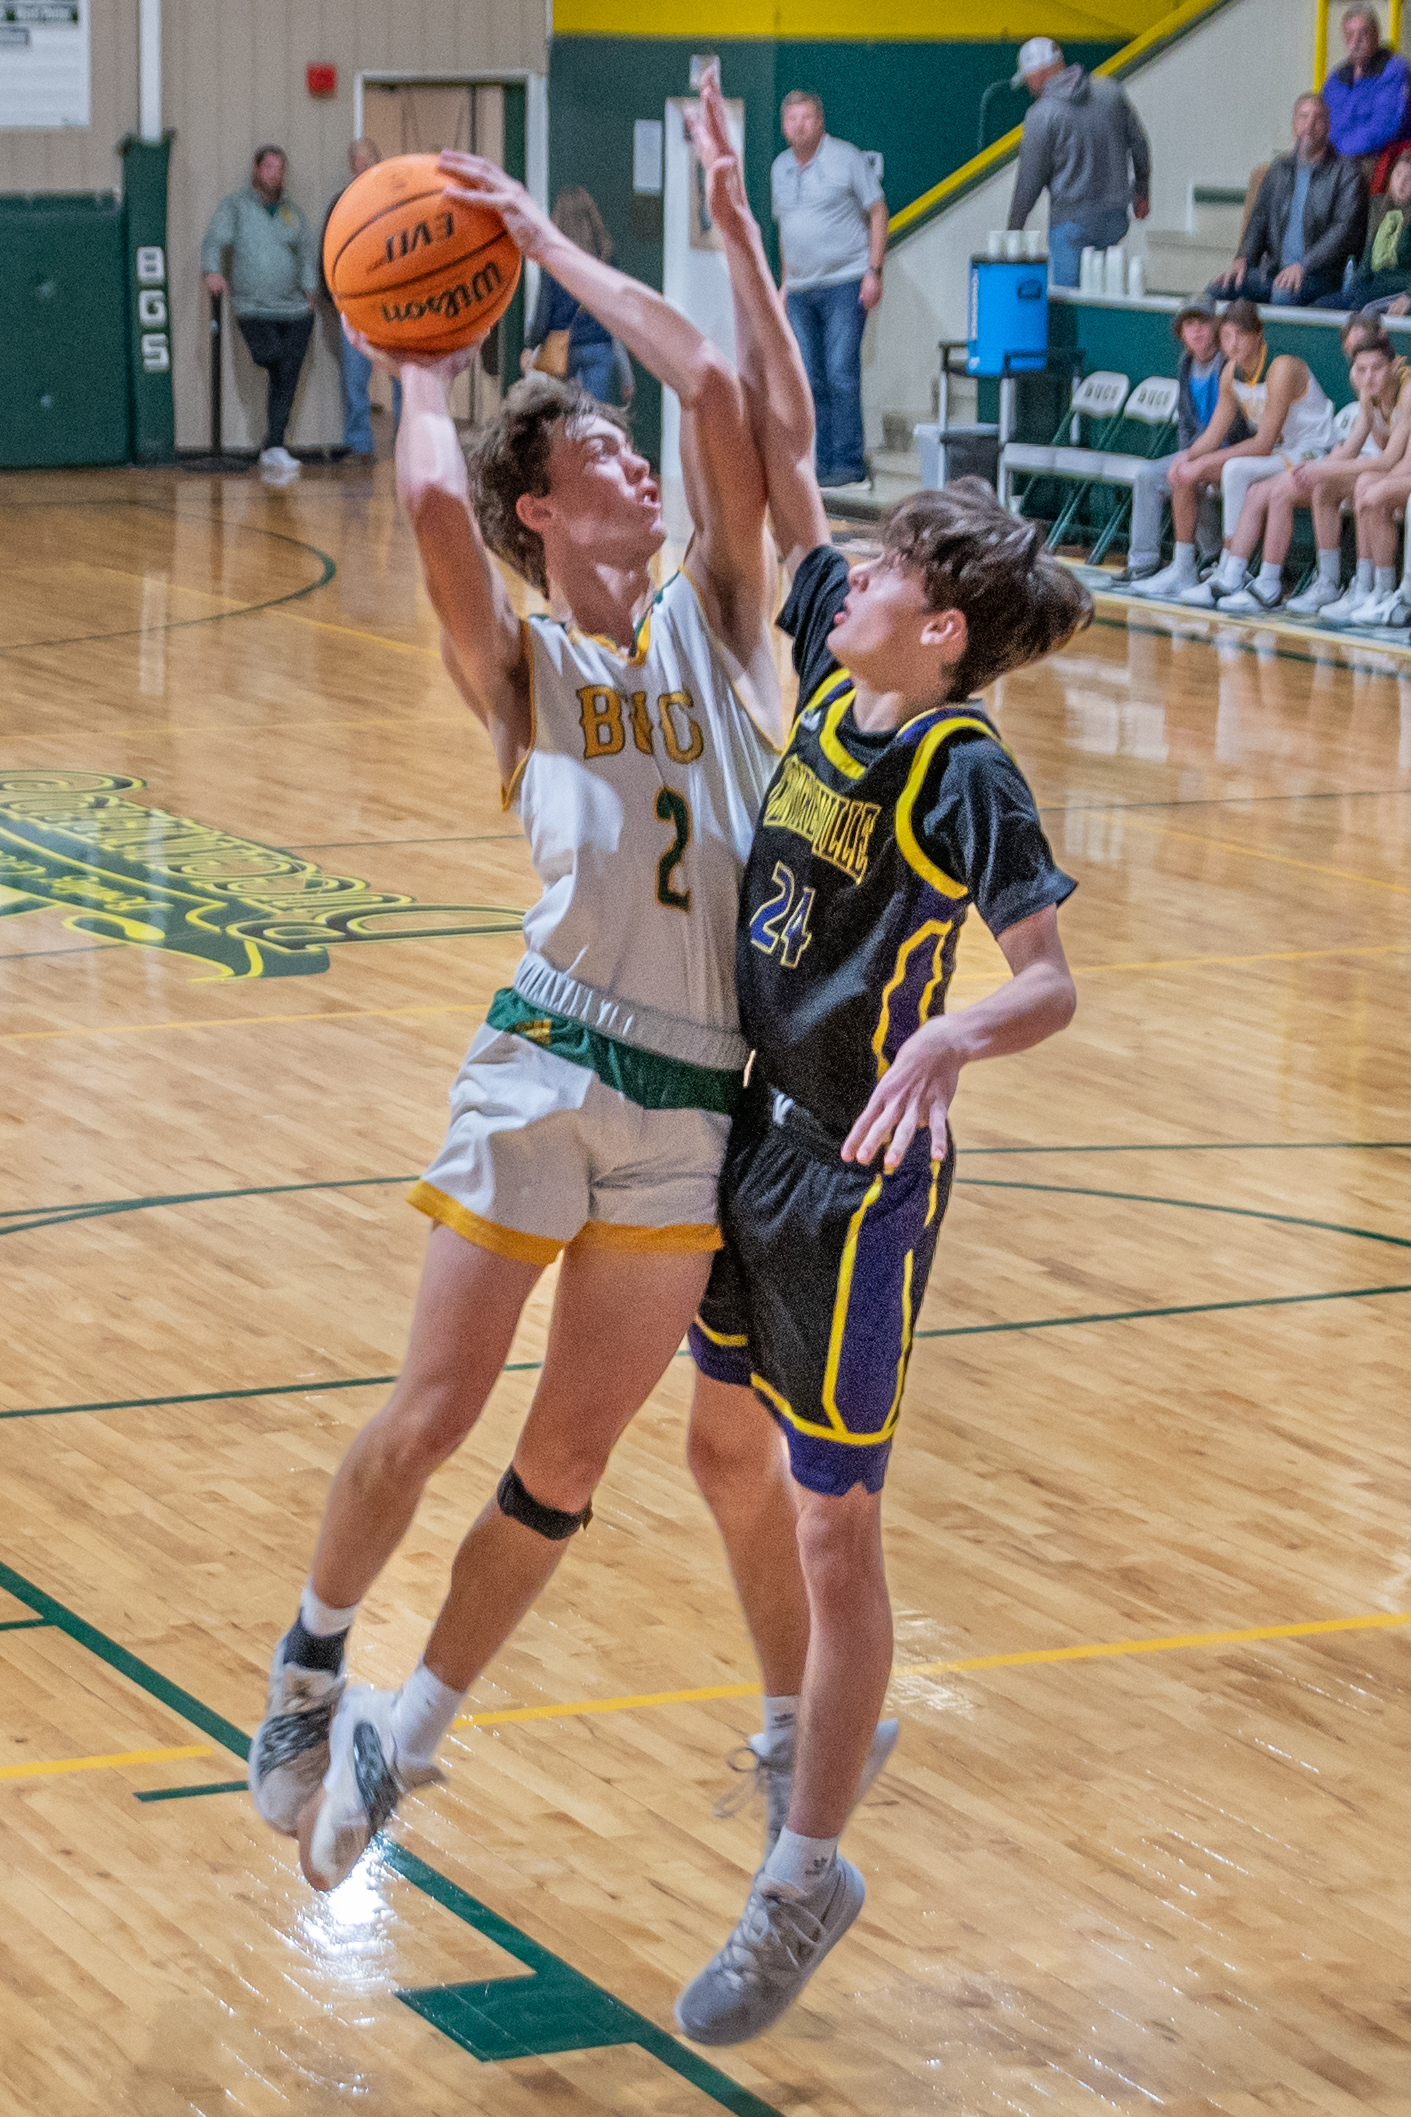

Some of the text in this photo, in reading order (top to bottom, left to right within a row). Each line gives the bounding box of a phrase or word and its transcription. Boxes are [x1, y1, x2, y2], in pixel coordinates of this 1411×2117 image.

[136, 246, 170, 373] BGS
[380, 261, 503, 323] Wilson
[654, 785, 693, 914] 2
[749, 860, 816, 969] 24
